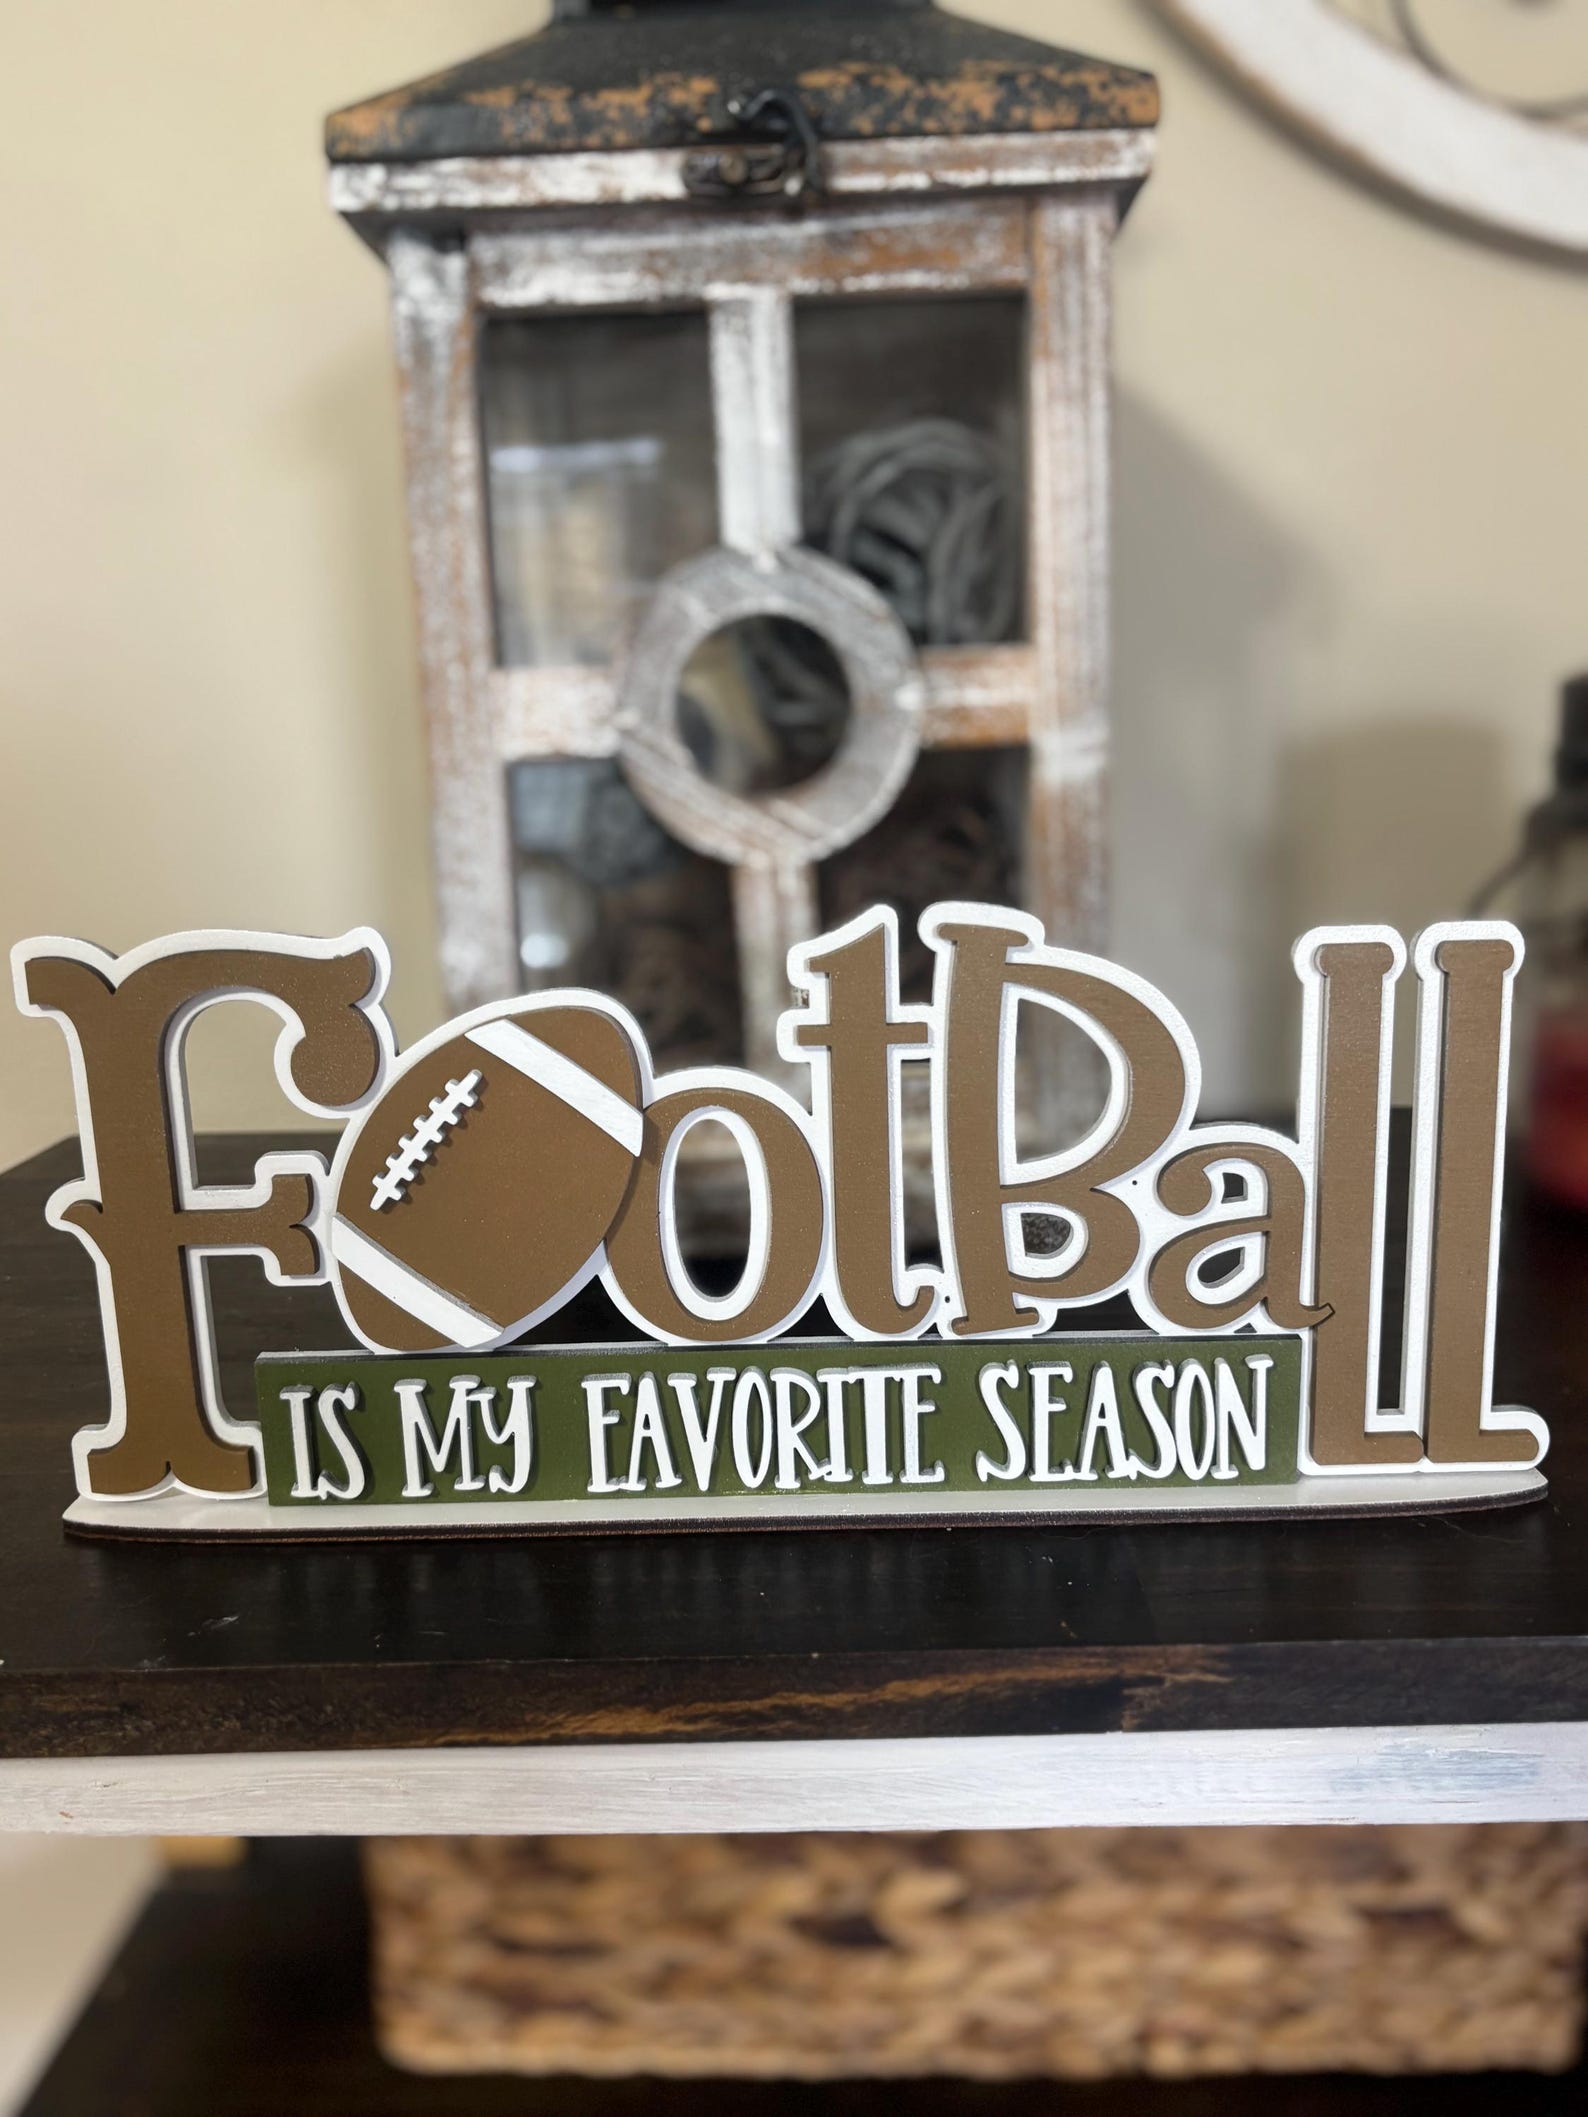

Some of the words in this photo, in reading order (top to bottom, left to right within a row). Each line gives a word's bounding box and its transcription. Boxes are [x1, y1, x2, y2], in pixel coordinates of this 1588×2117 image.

[279, 1382, 366, 1502] IS
[580, 1366, 945, 1493] FAVORITE
[975, 1353, 1275, 1483] SEASON
